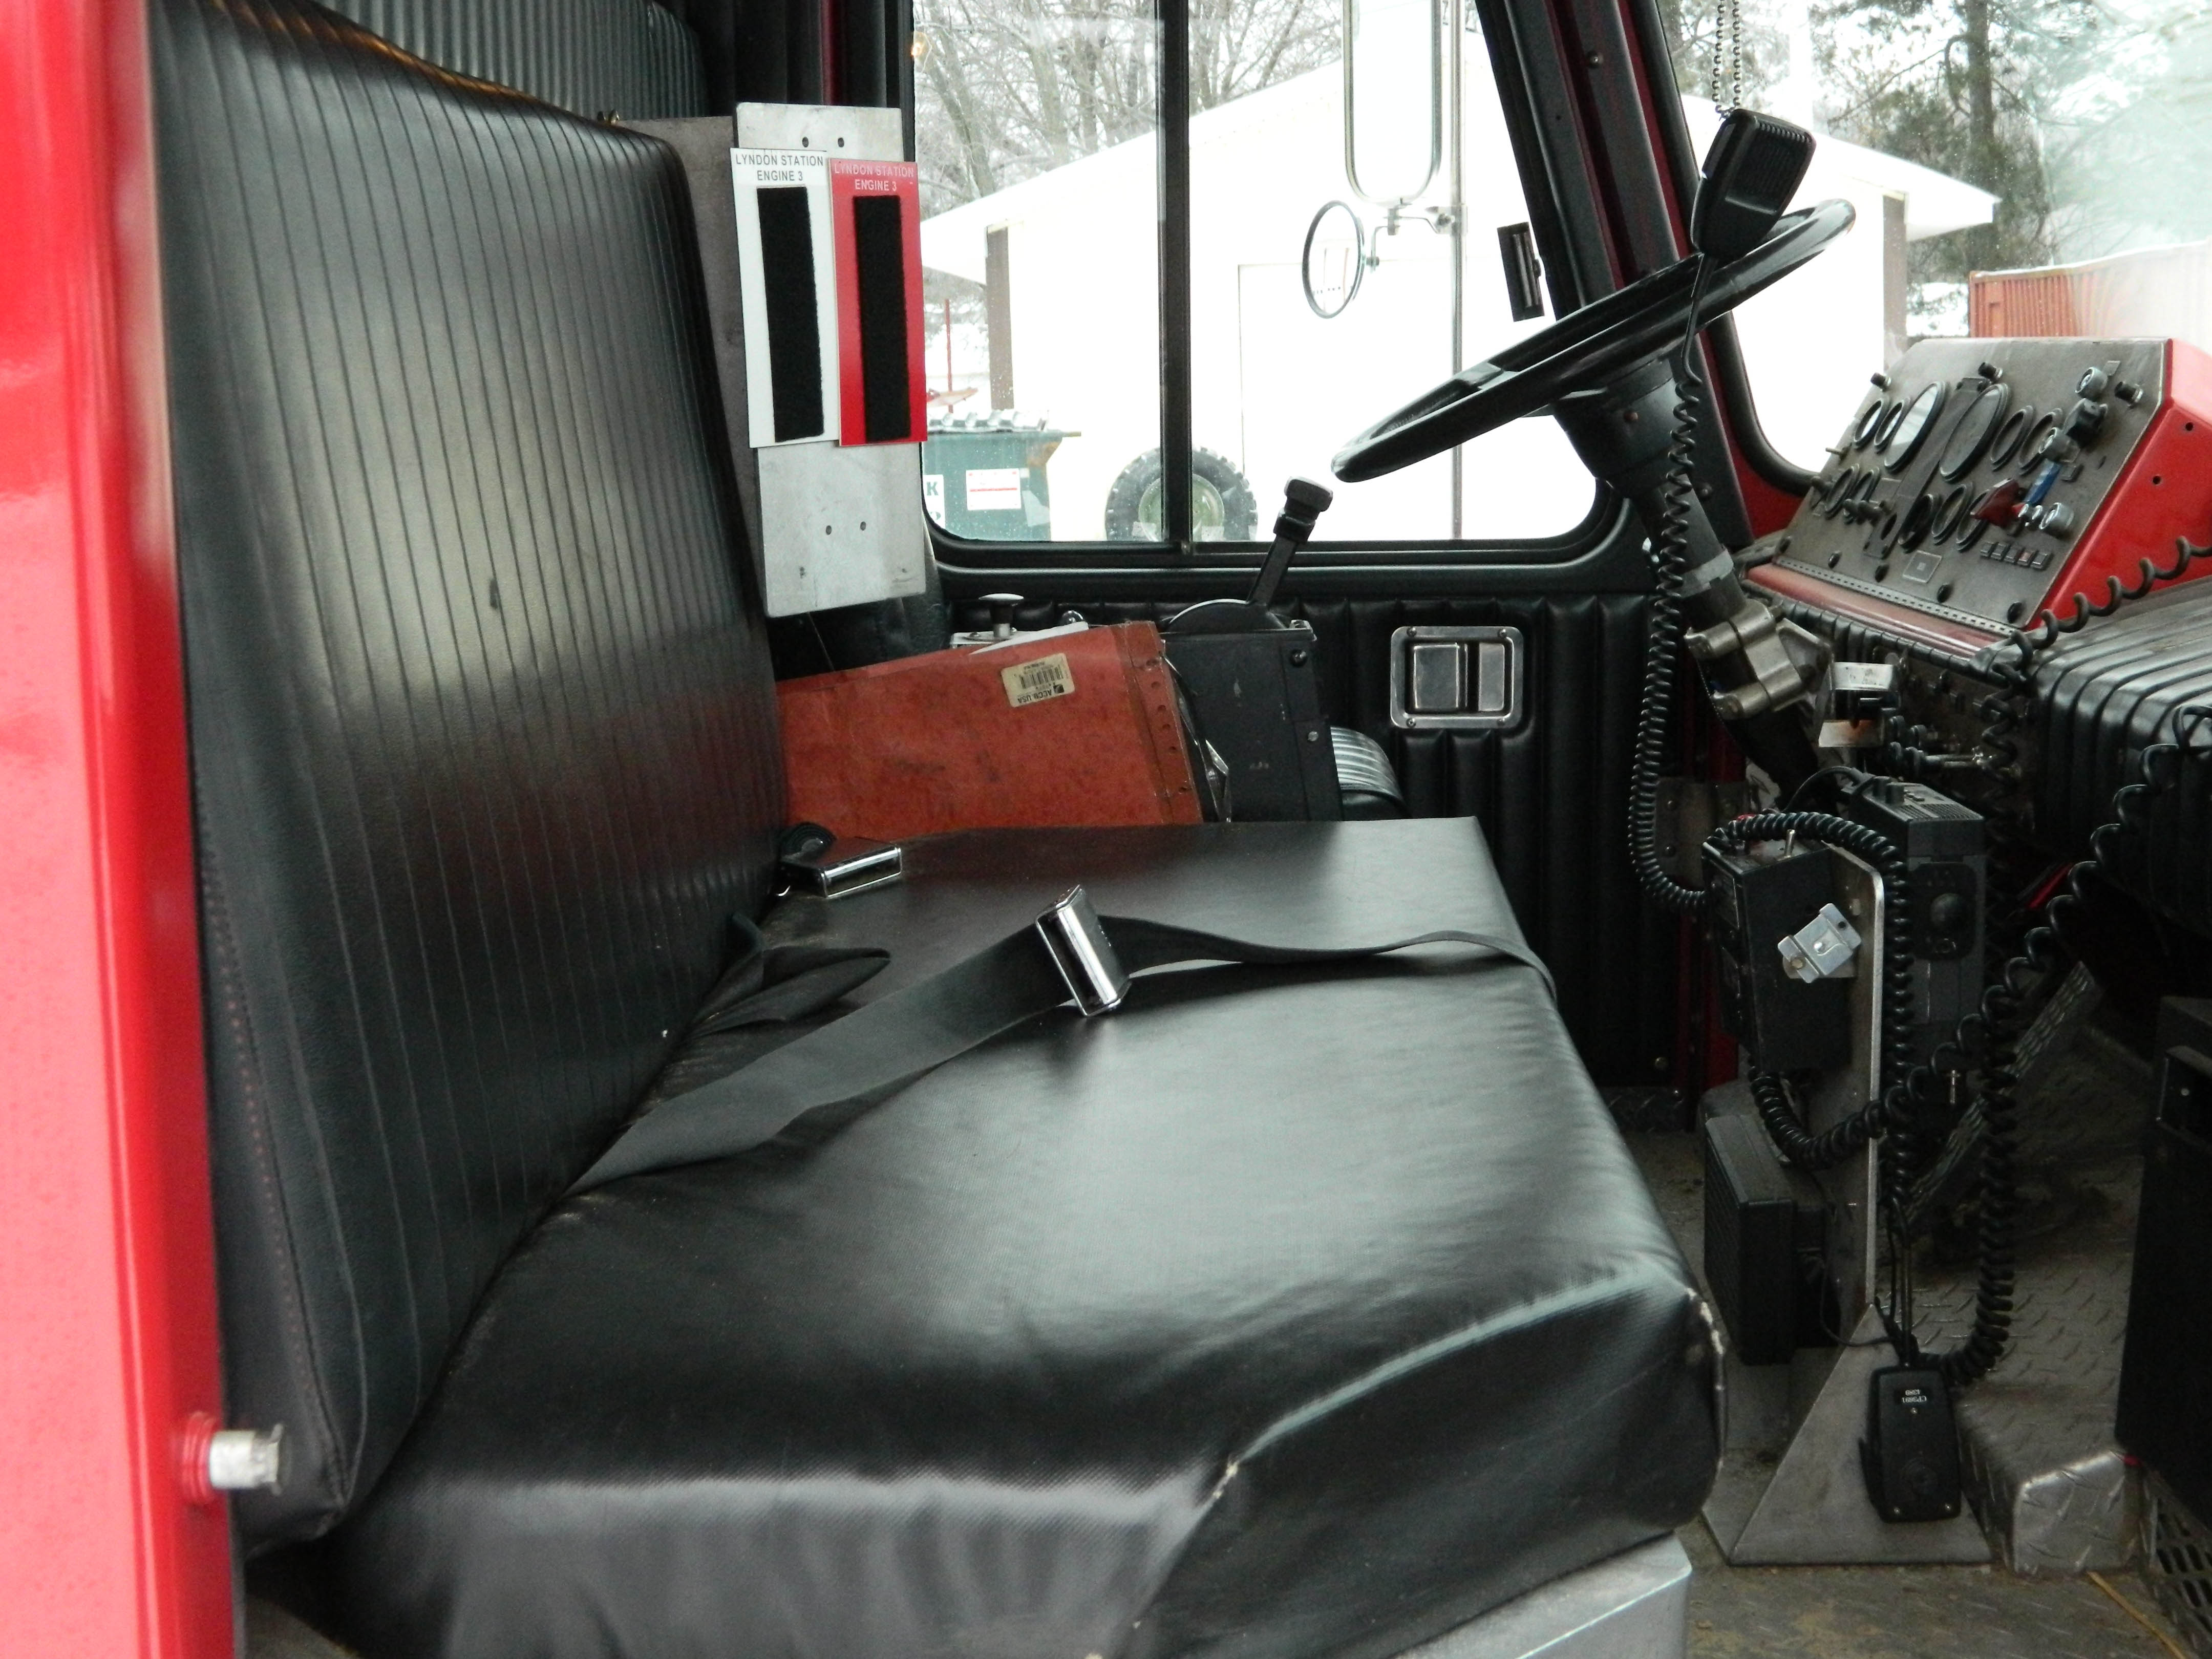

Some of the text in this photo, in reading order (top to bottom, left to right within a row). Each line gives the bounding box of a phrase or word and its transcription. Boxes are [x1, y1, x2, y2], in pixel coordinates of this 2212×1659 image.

[736, 154, 823, 166] LYNDON STATION
[757, 170, 803, 181] ENGINE 3
[835, 163, 914, 177] LYNDON STATION
[855, 179, 897, 192] ENGINE 3
[1017, 694, 1032, 704] USA
